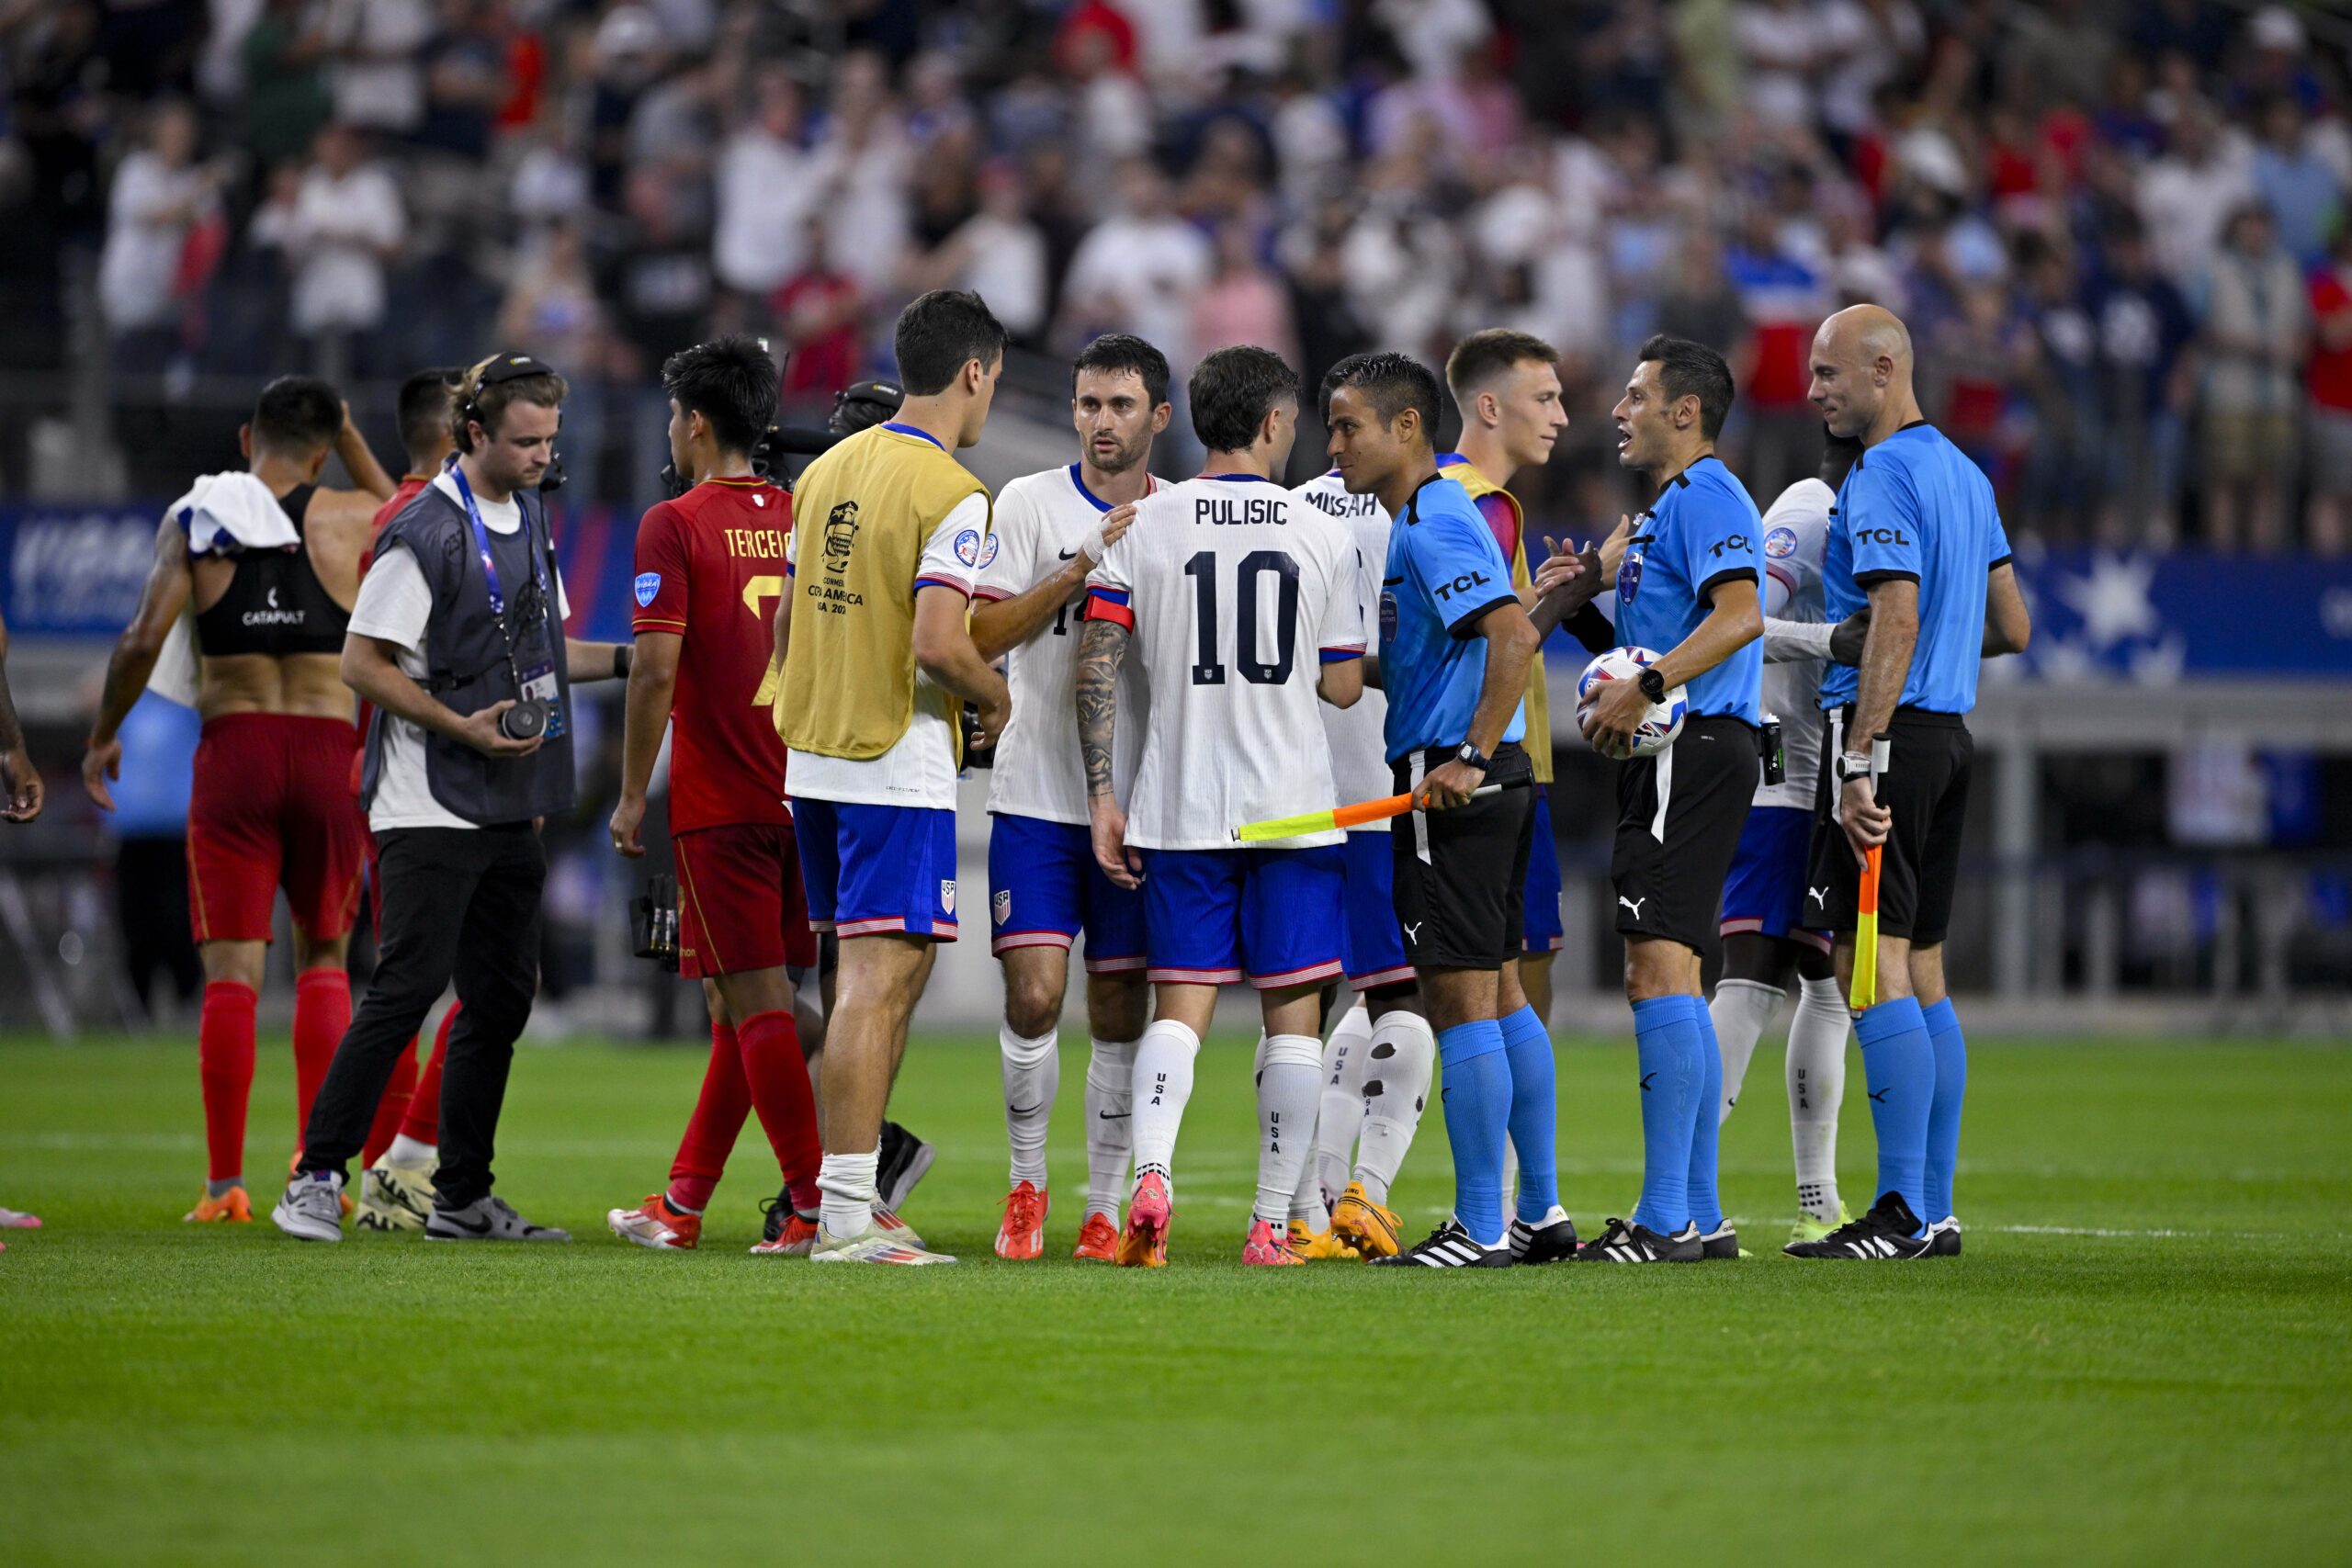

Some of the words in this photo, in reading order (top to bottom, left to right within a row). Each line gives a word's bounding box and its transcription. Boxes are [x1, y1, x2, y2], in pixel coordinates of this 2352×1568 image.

[1195, 499, 1288, 525] PULISIC
[1709, 534, 1753, 558] TCL
[1856, 528, 1910, 546] TCL
[1434, 570, 1491, 602] TCL
[242, 610, 306, 626] CATAPULT
[1184, 550, 1300, 684] 10
[942, 881, 955, 895] USA
[1329, 1046, 1349, 1085] USA
[1150, 1072, 1167, 1106] USA
[1797, 1067, 1808, 1110] USA
[1271, 1111, 1280, 1154] USA
